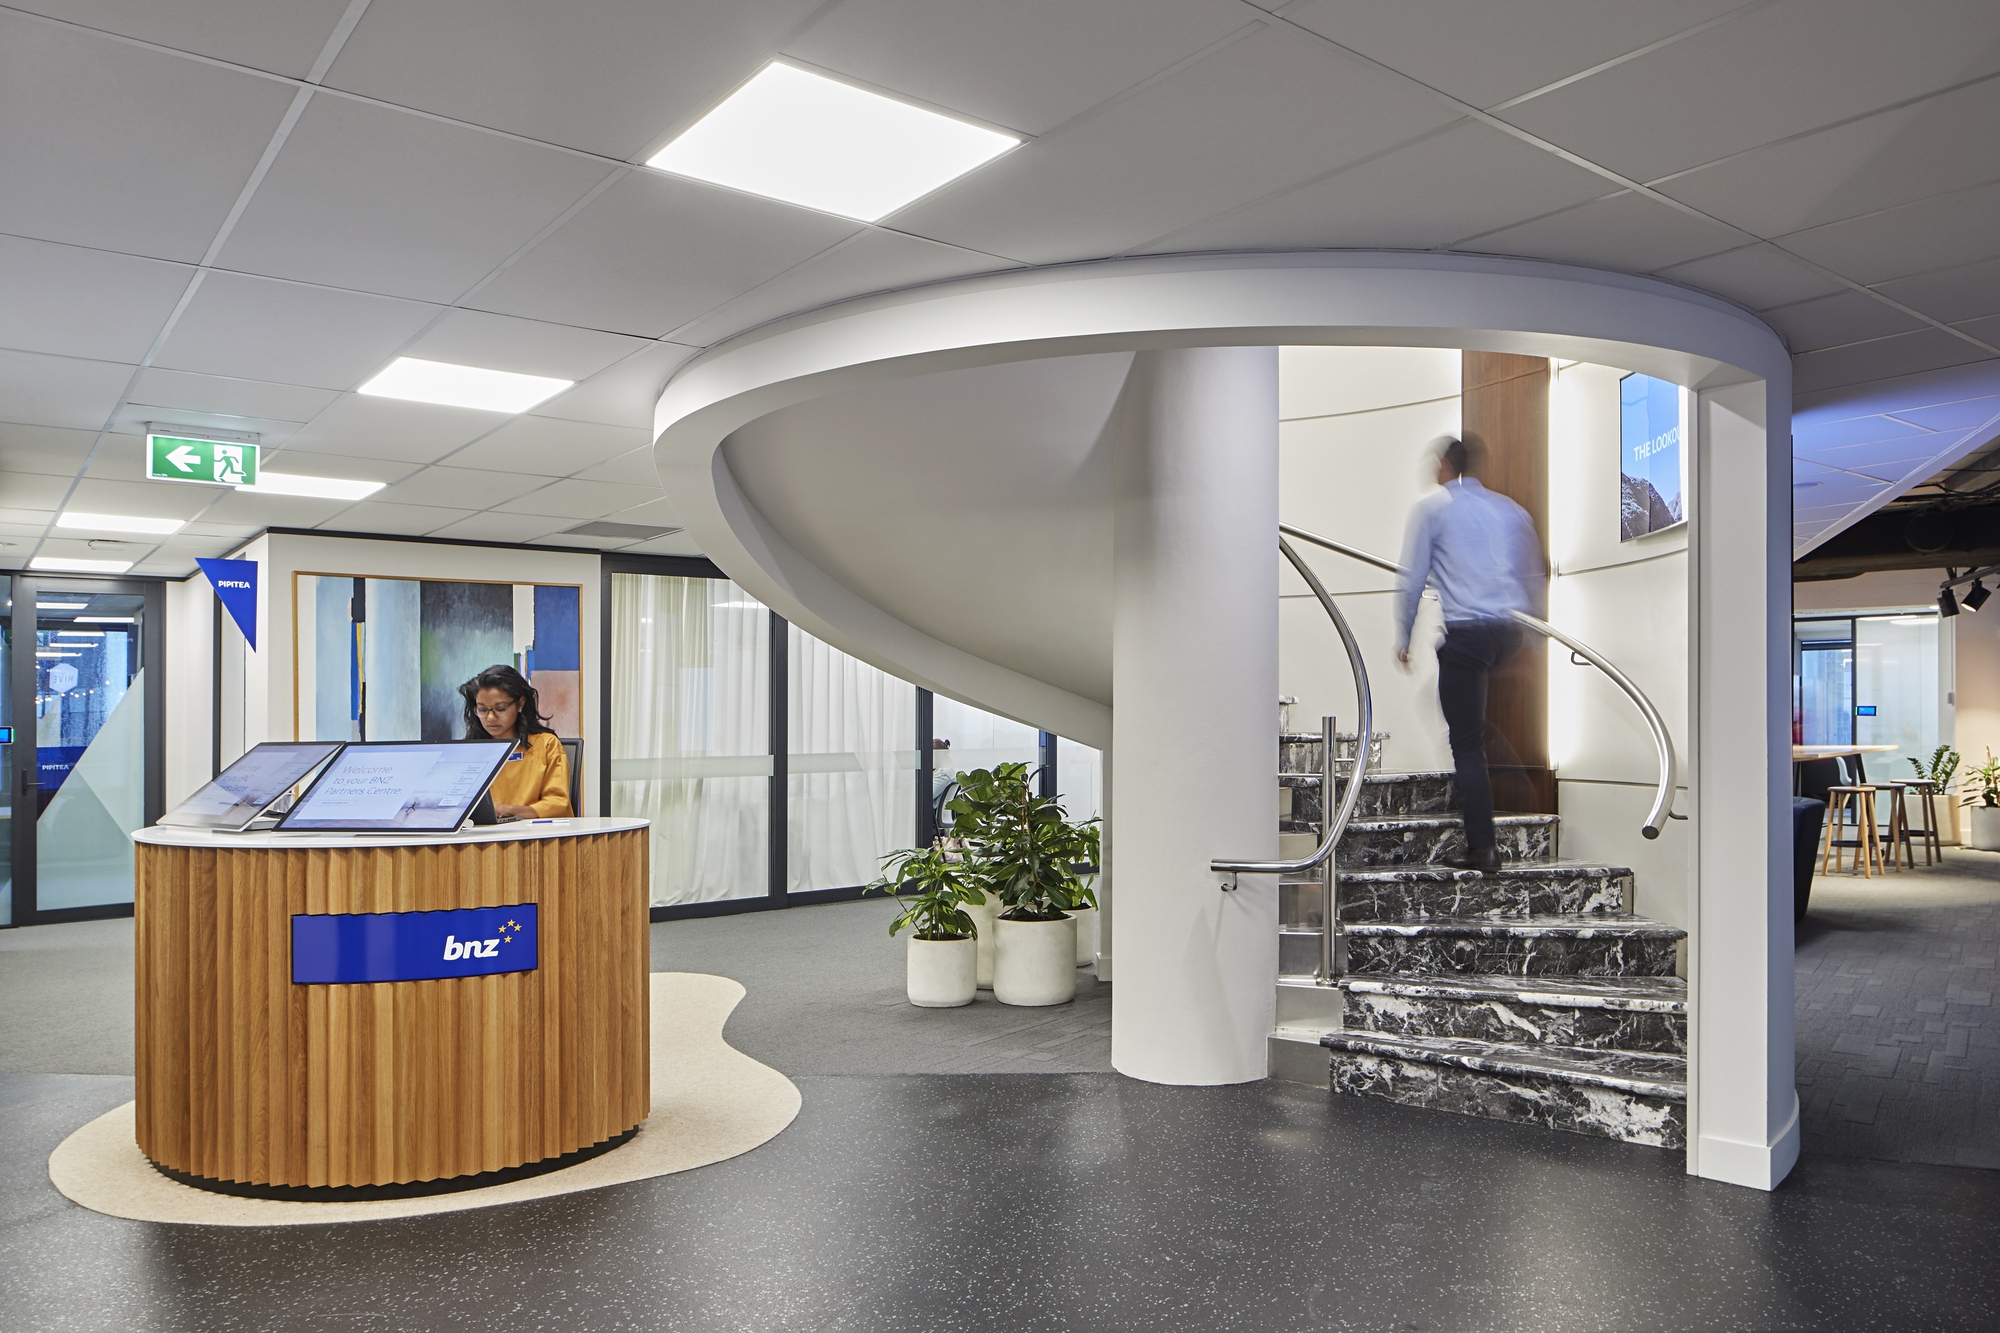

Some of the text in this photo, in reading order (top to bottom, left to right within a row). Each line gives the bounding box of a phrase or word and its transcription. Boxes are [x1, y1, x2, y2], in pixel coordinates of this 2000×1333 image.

[1634, 441, 1651, 461] THE
[218, 580, 250, 588] PIPITEA
[342, 765, 393, 774] Welcome
[333, 776, 393, 787] to your BNZ
[324, 786, 402, 795] Partners Centre.
[443, 935, 500, 961] bnz
